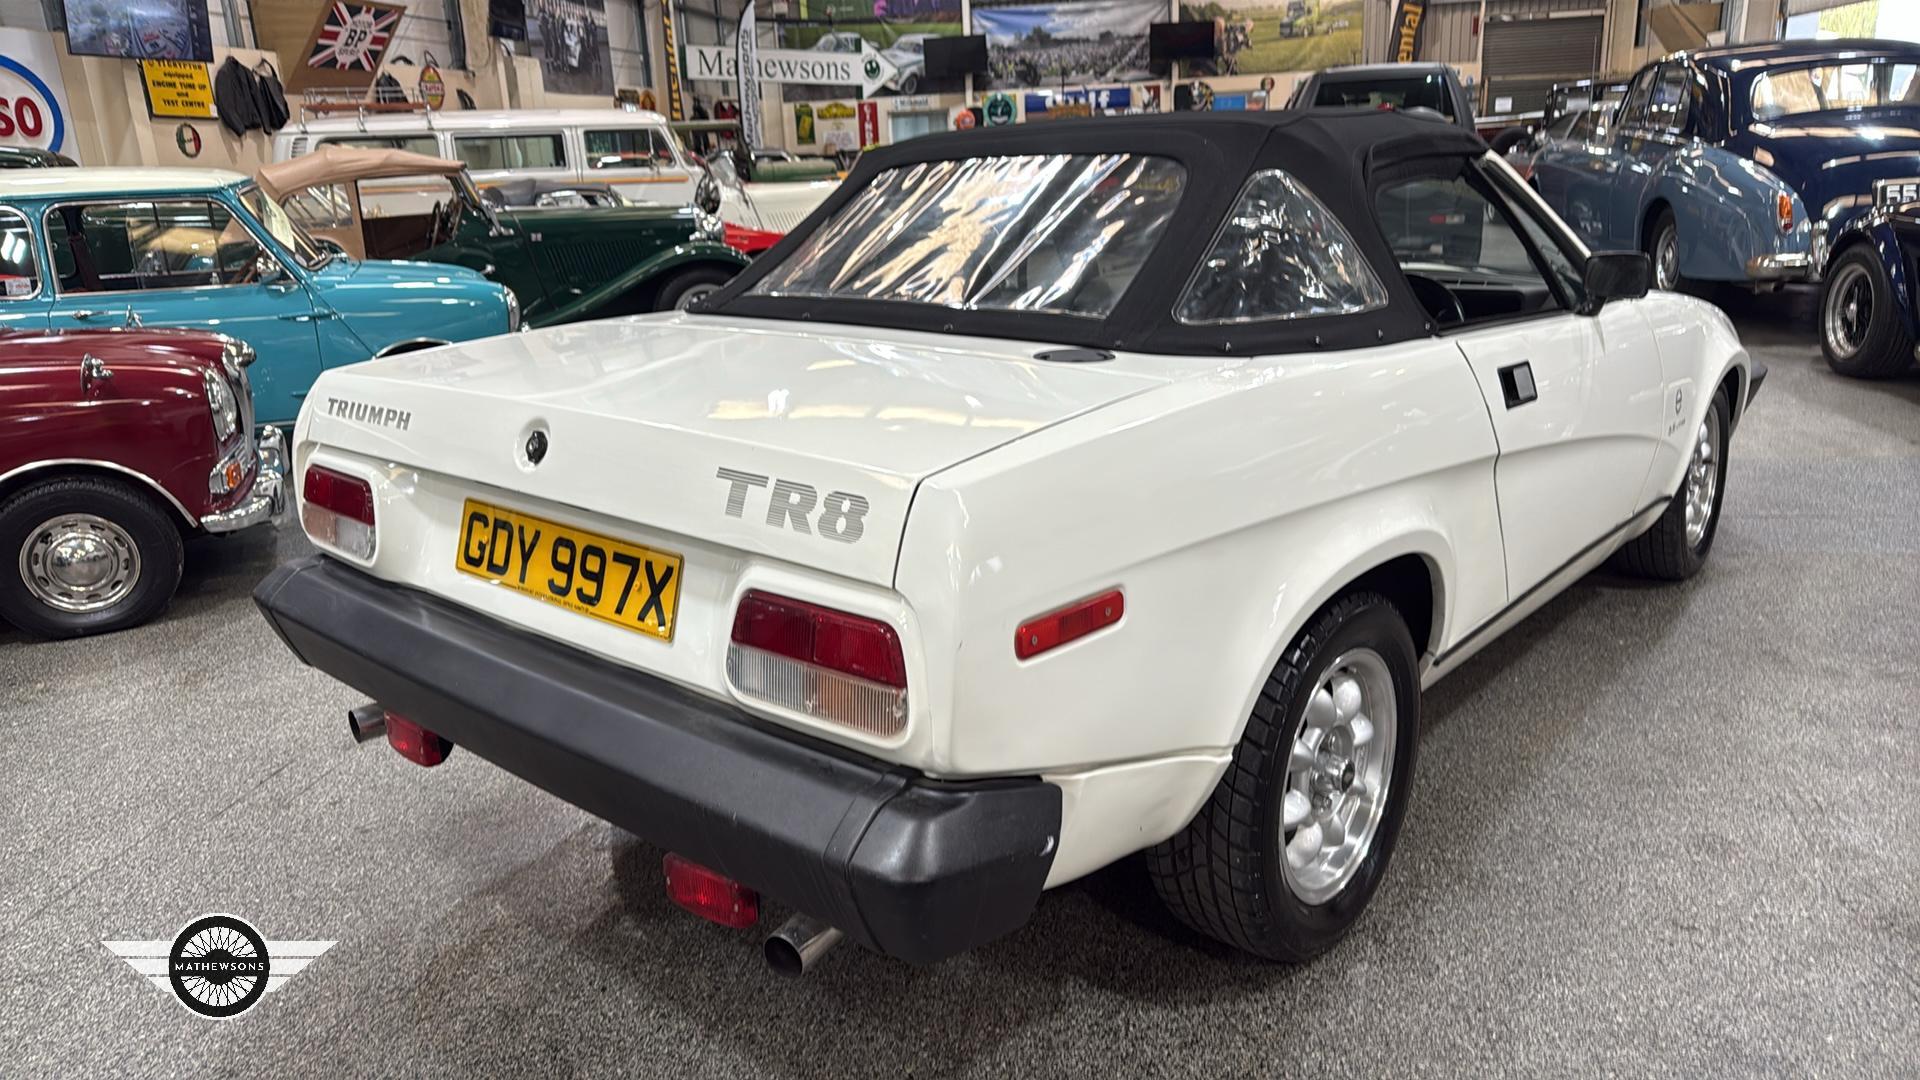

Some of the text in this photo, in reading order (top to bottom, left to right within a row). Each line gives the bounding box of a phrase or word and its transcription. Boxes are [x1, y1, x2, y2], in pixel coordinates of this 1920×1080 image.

[344, 29, 368, 48] BP
[699, 49, 850, 81] Maewsons
[179, 82, 196, 90] TUNE
[162, 98, 179, 107] TEST
[327, 397, 412, 432] TRIUMPH
[716, 466, 870, 545] TR8
[463, 511, 675, 628] GDY 997X
